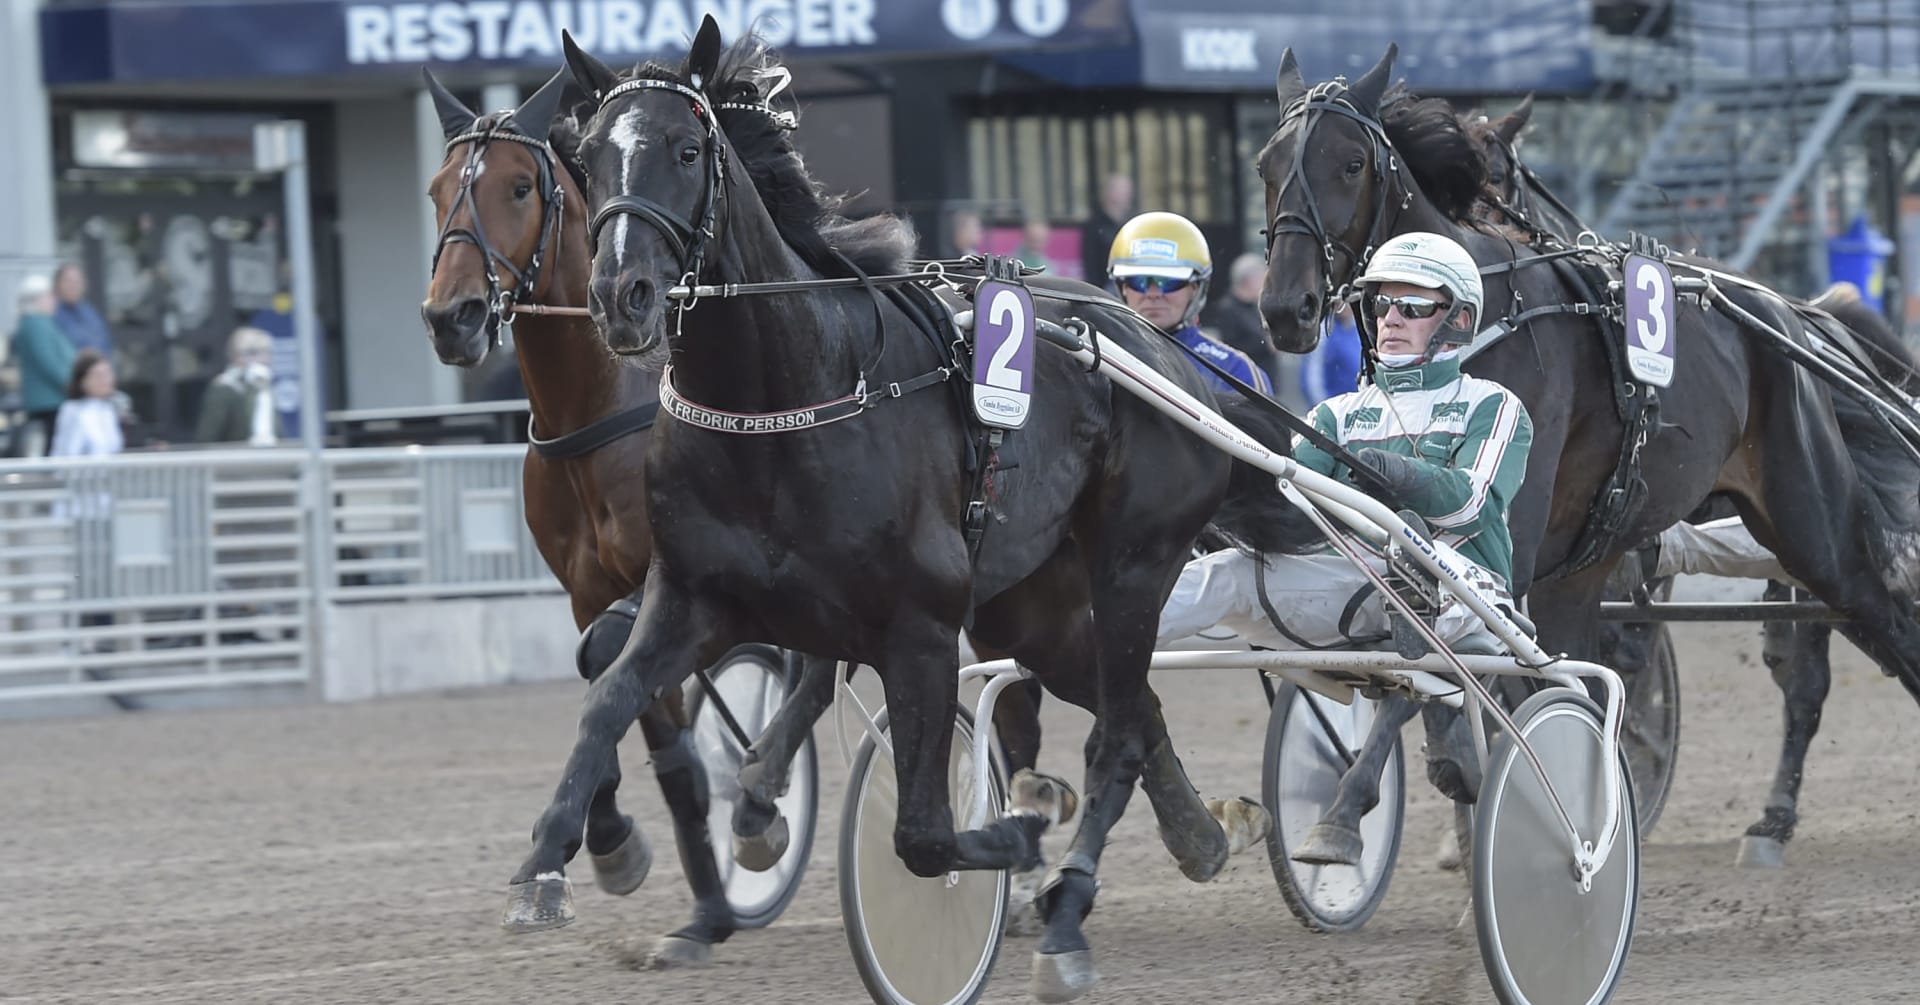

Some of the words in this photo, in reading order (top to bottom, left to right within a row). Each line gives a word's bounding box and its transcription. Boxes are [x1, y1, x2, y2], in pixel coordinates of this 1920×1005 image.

[347, 0, 876, 63] RESTAURANGER
[986, 290, 1025, 391] 2
[1637, 264, 1667, 354] 3
[675, 402, 739, 431] FREDRIK
[743, 411, 815, 431] PERSSON
